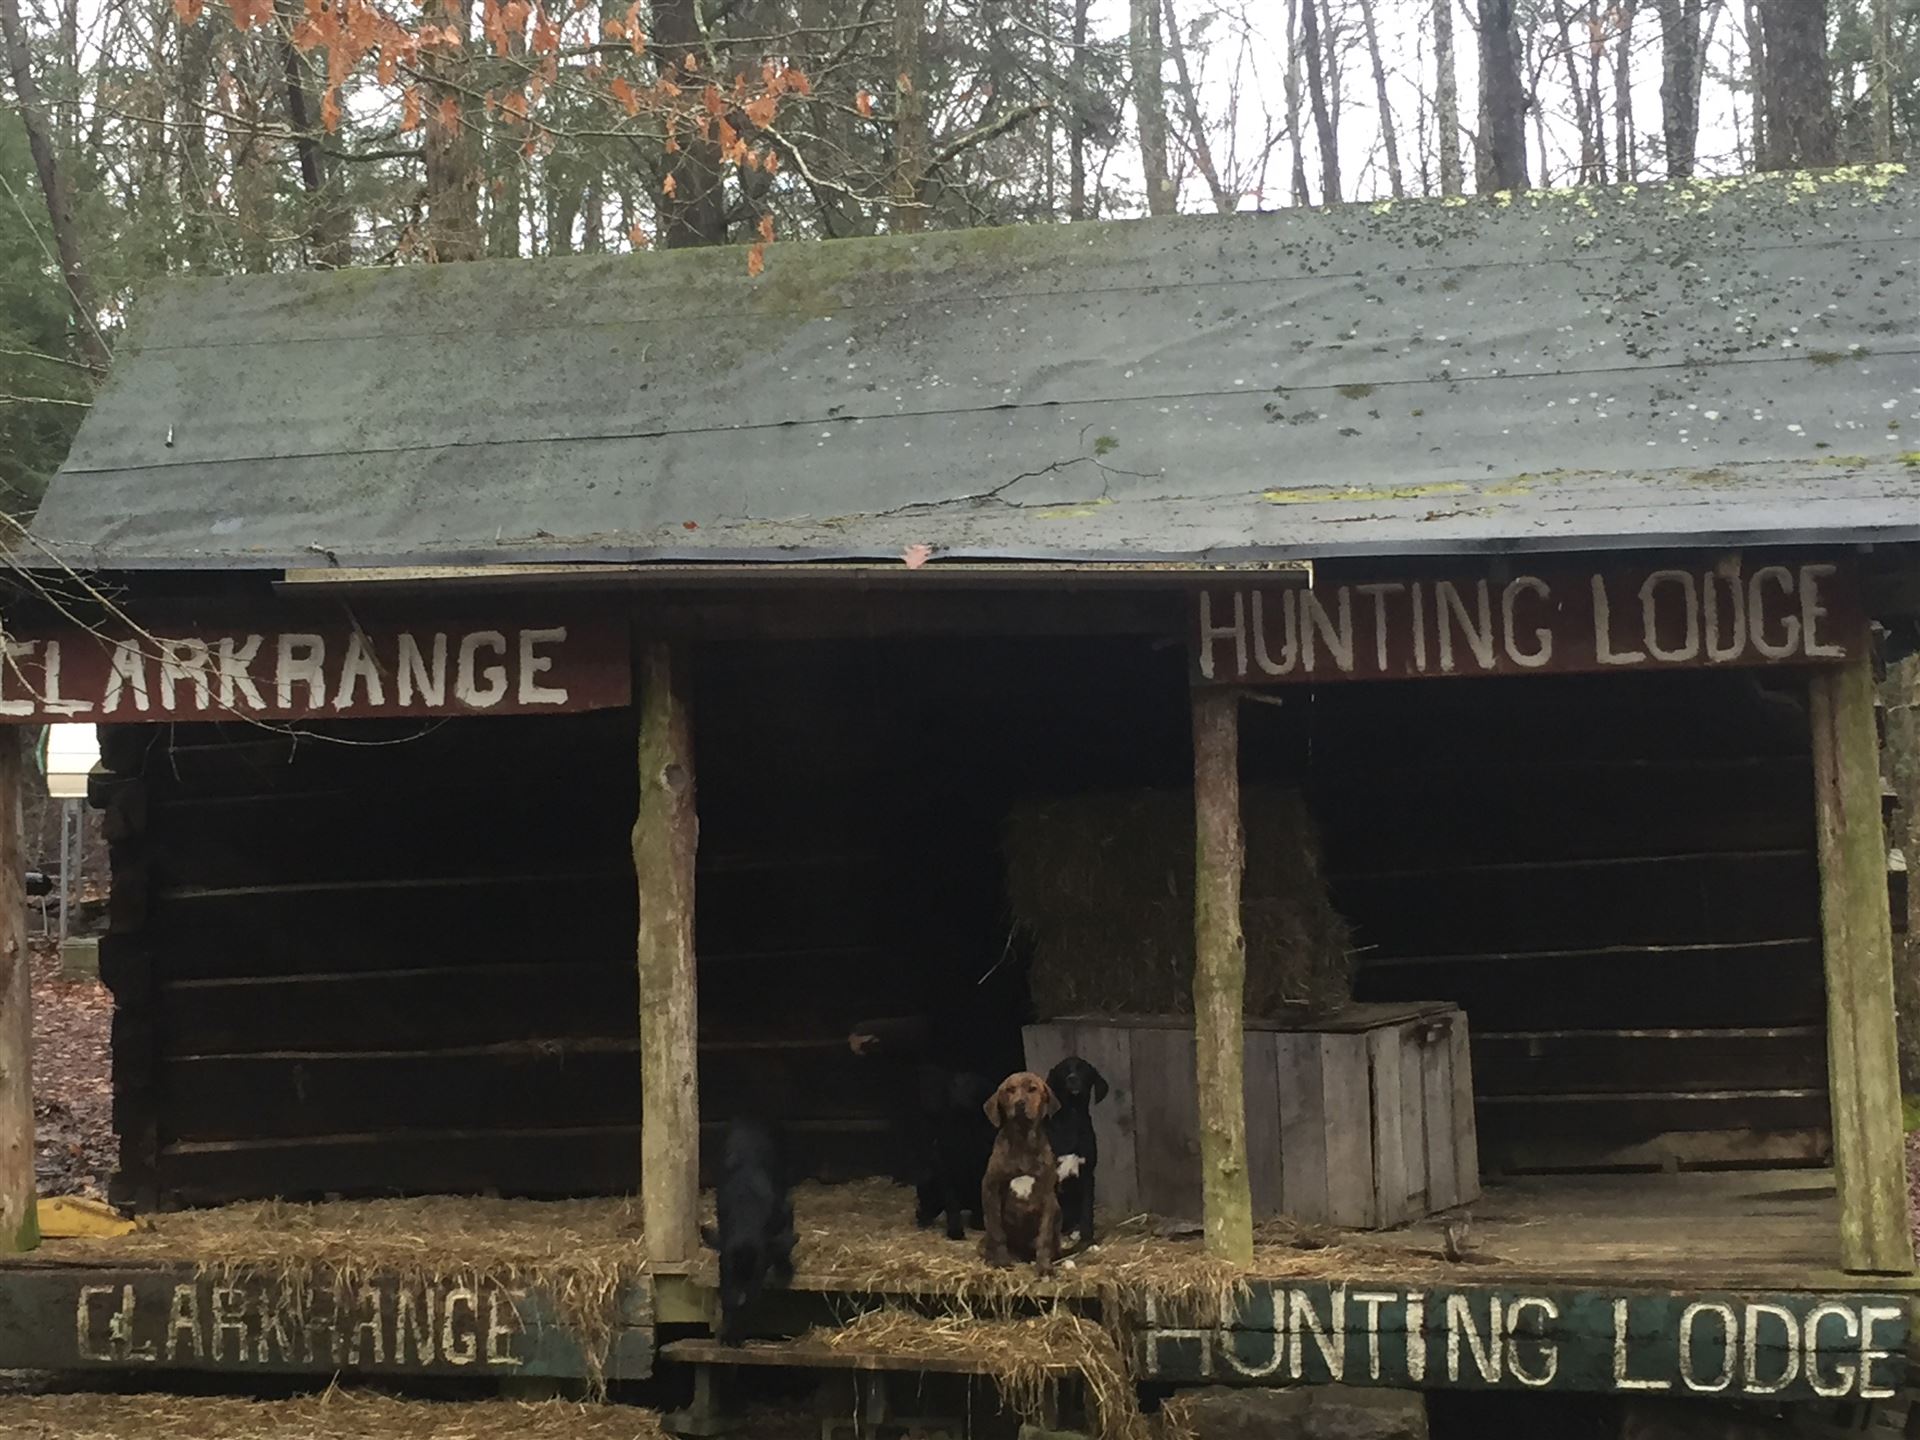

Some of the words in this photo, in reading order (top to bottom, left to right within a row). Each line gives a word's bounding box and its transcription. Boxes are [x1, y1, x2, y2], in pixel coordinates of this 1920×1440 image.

[1200, 576, 1552, 678] HUNTING
[1591, 564, 1846, 665] LODGE
[1146, 1287, 1558, 1386] HUNTING
[1614, 1297, 1901, 1398] LODGE
